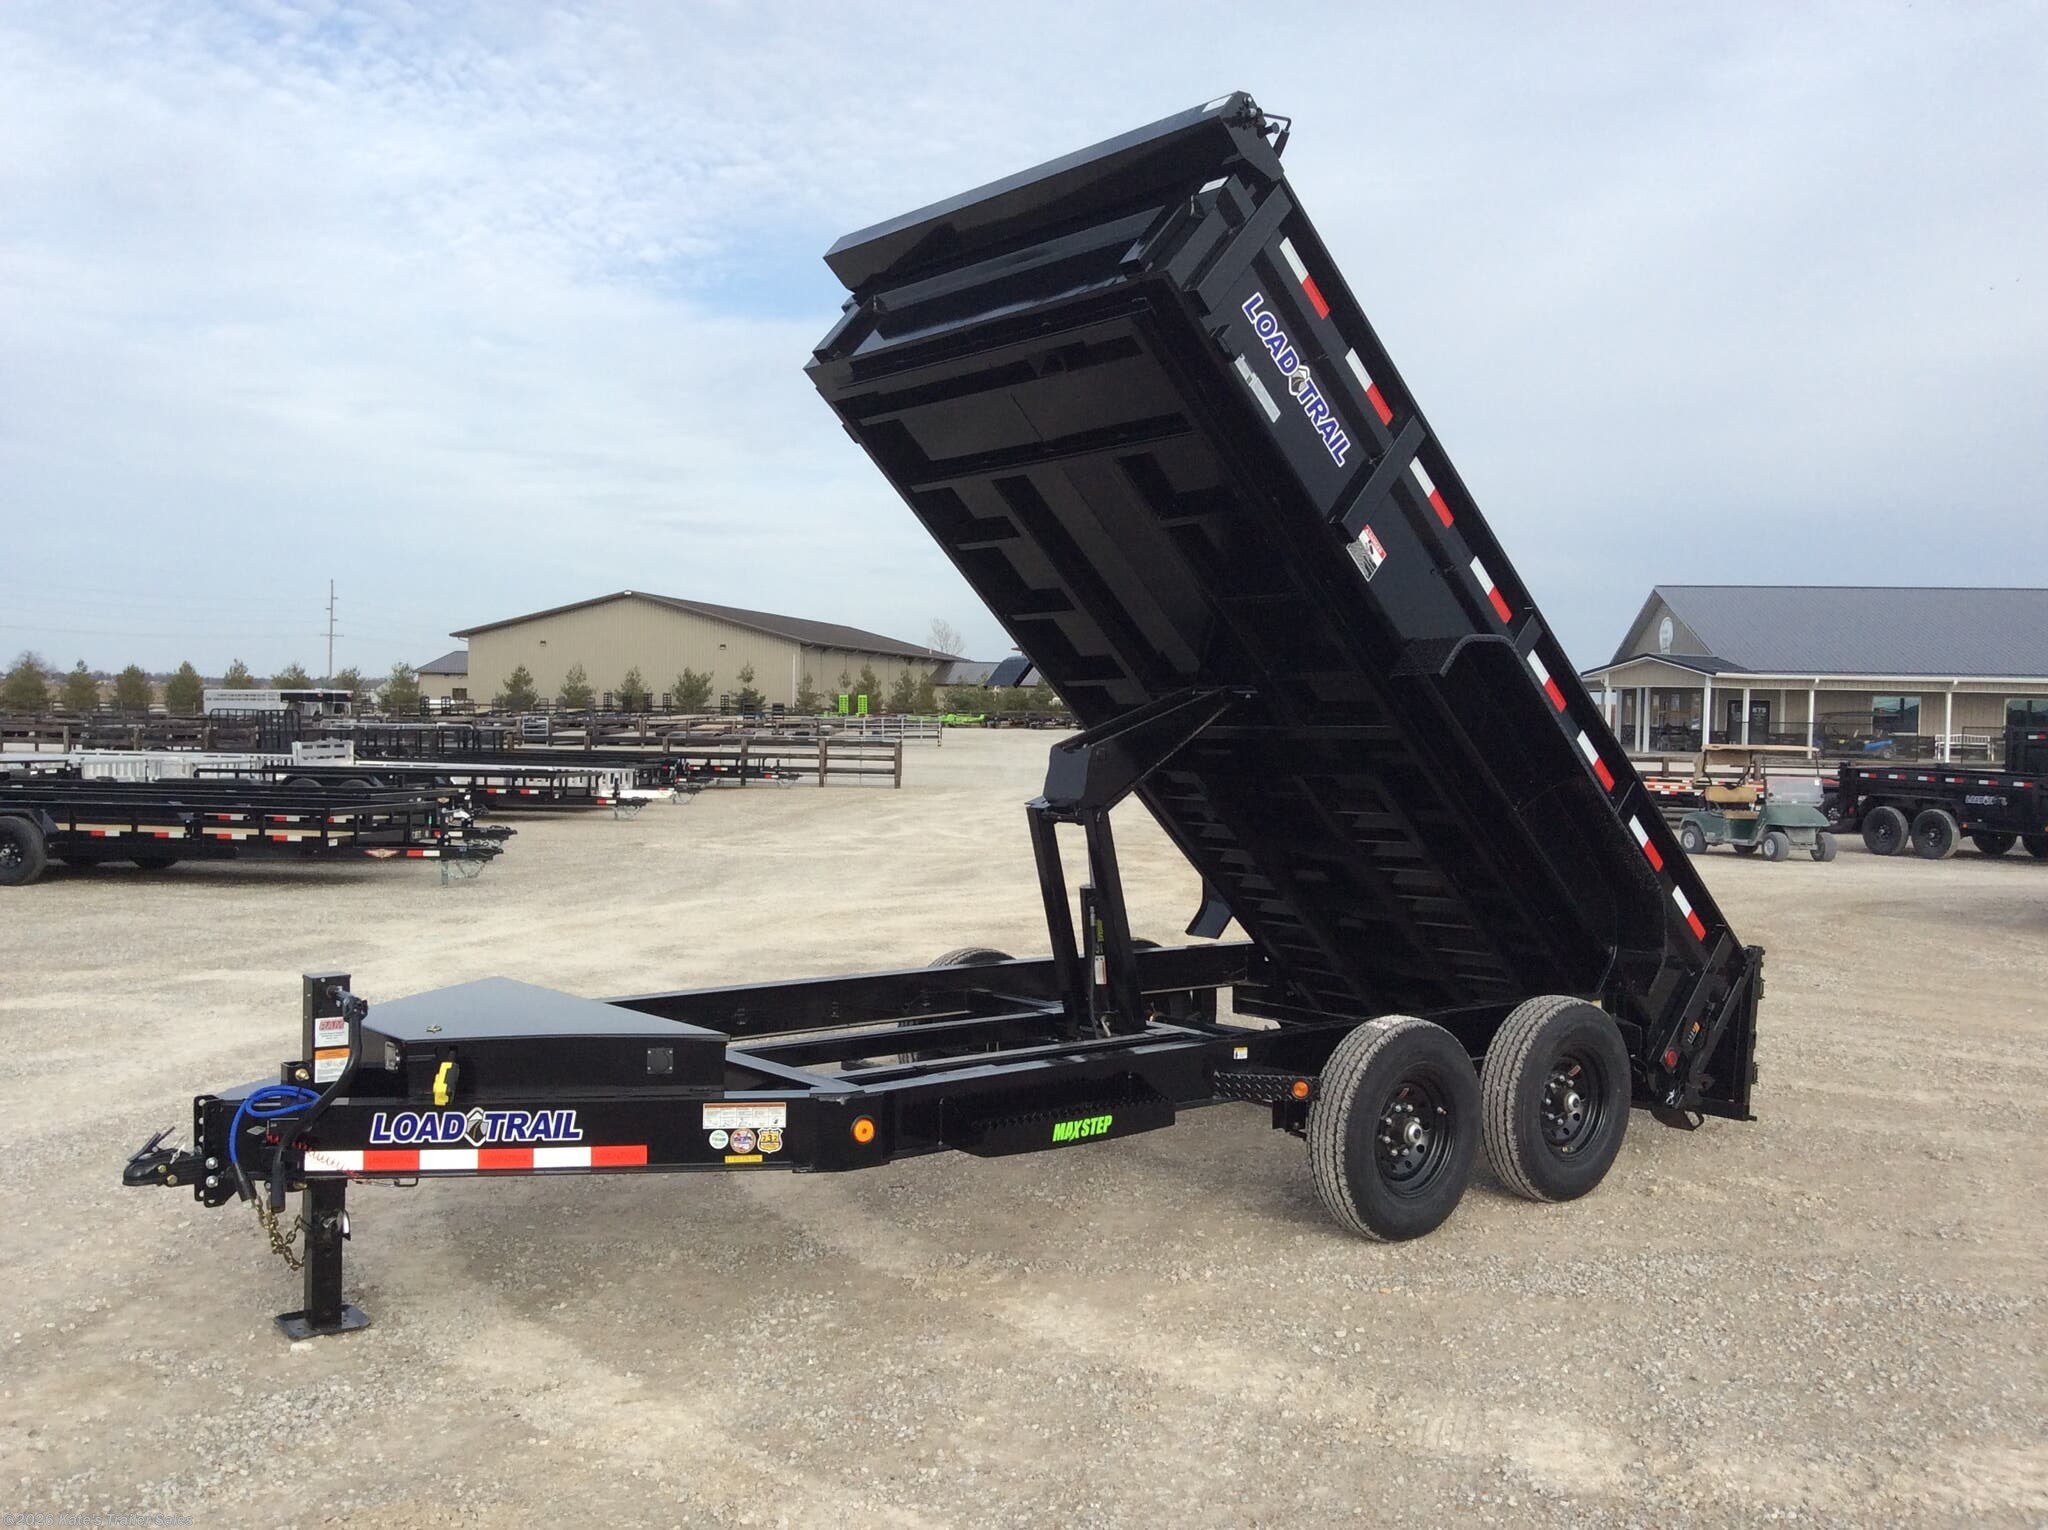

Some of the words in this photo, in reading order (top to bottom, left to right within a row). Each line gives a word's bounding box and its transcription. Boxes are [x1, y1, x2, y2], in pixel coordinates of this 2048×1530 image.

[1242, 293, 1299, 375] LOAD
[1297, 379, 1351, 467] TRAIL
[370, 1112, 467, 1143] LOAD
[483, 1111, 583, 1141] TRAIL
[1053, 1115, 1113, 1142] MAXSTEP
